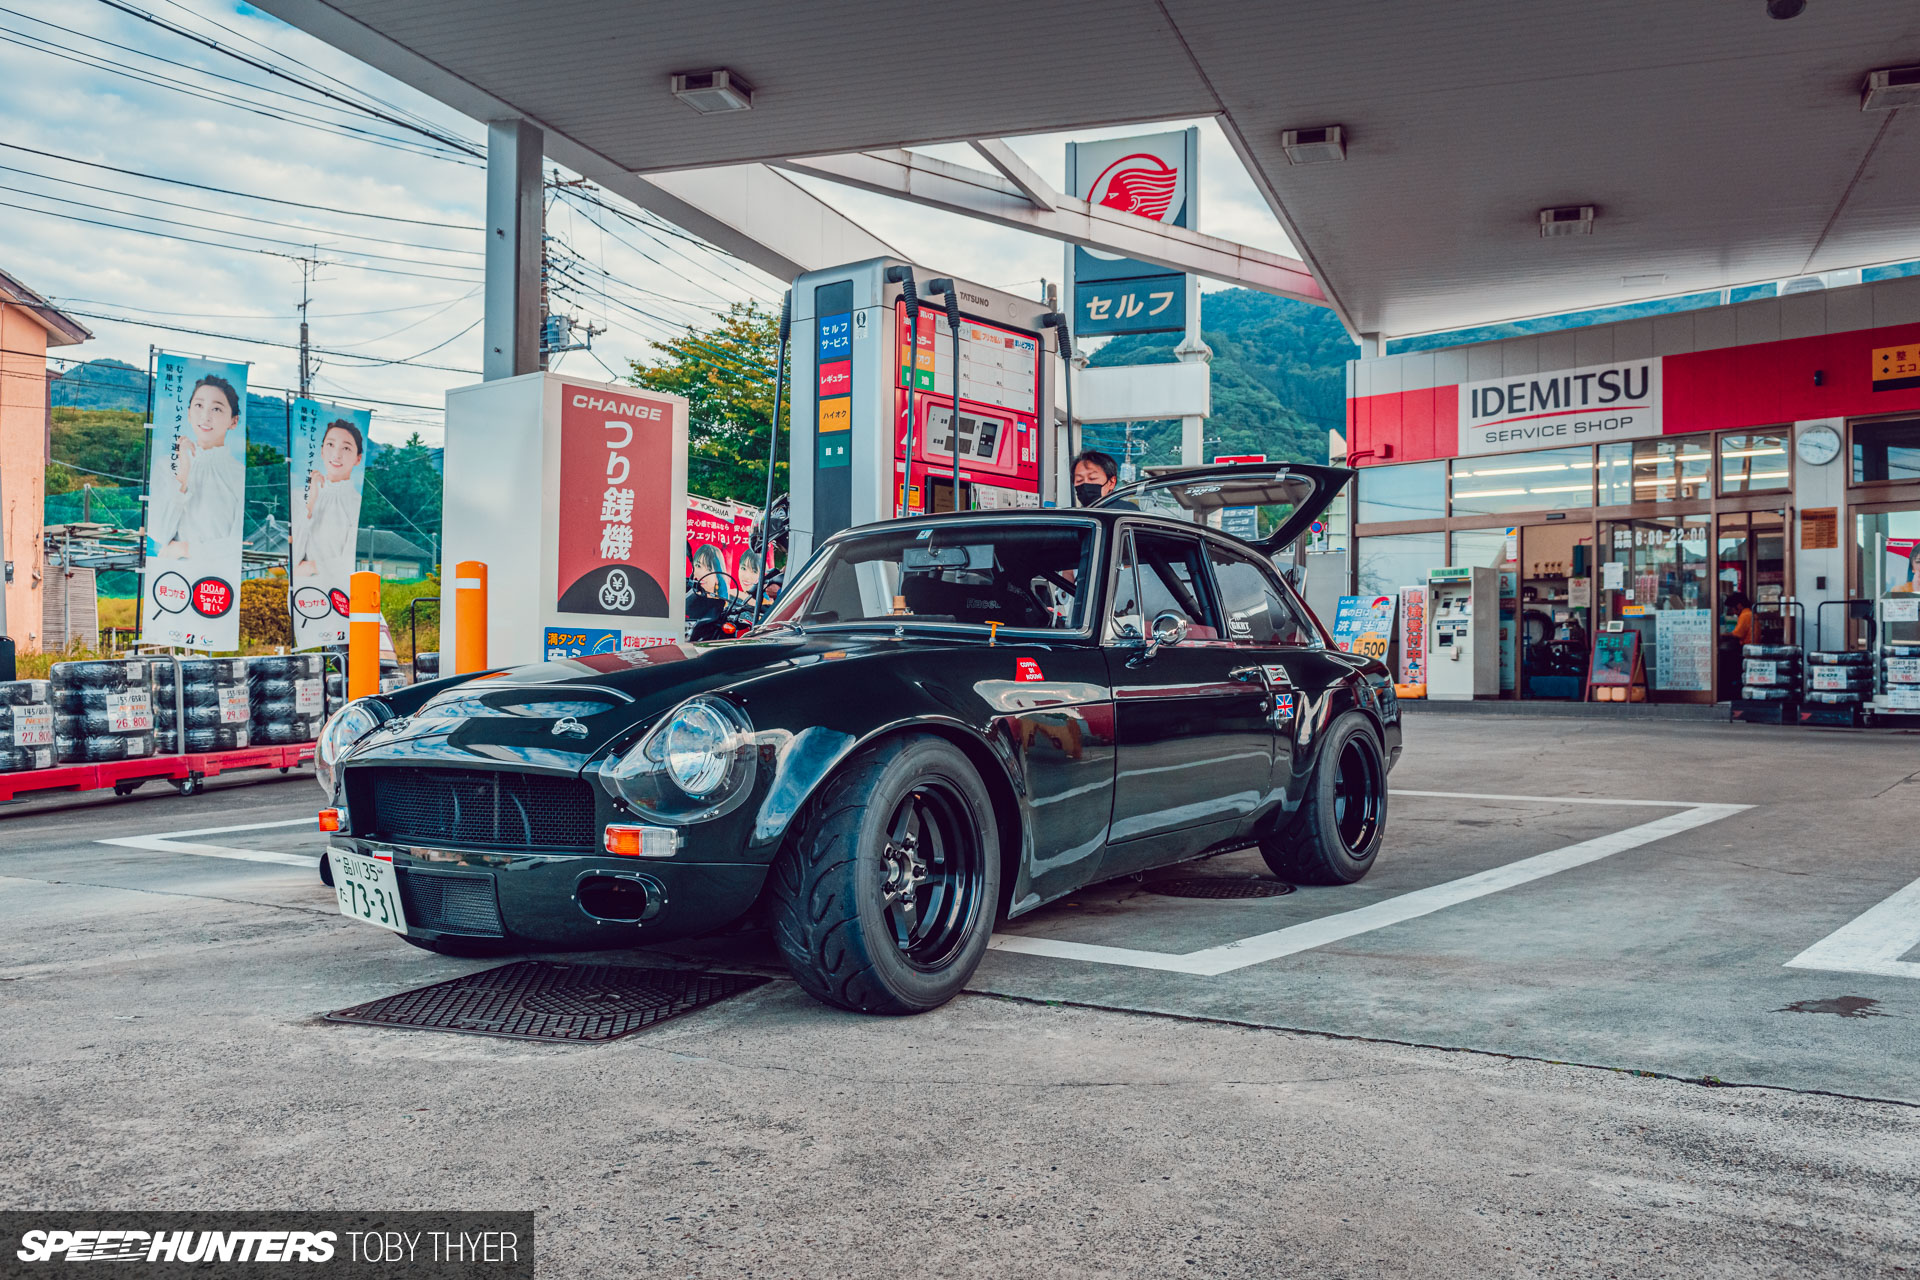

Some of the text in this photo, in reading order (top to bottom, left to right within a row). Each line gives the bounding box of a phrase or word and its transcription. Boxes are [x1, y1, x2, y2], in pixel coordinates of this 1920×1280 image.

[960, 291, 989, 307] TATSUNO
[1086, 292, 1174, 320] セルフ
[822, 323, 848, 336] セルフ
[822, 336, 848, 350] サービス
[1896, 364, 1917, 374] エコ
[821, 374, 849, 384] レギュラー
[1472, 366, 1648, 418] IDEMITSU
[572, 394, 662, 421] CHANGE
[824, 410, 846, 419] ハイオク
[1485, 416, 1633, 443] SERVICE SHOP
[600, 420, 634, 560] つり銭機
[700, 503, 729, 516] YOKOHAMA
[160, 586, 186, 599] 見つかる
[1340, 608, 1370, 617] 雨の日は
[1406, 591, 1423, 662] 車検受付中
[548, 632, 586, 646] 満タンで
[343, 857, 378, 882] 品川 35
[340, 880, 398, 927] た 73-31
